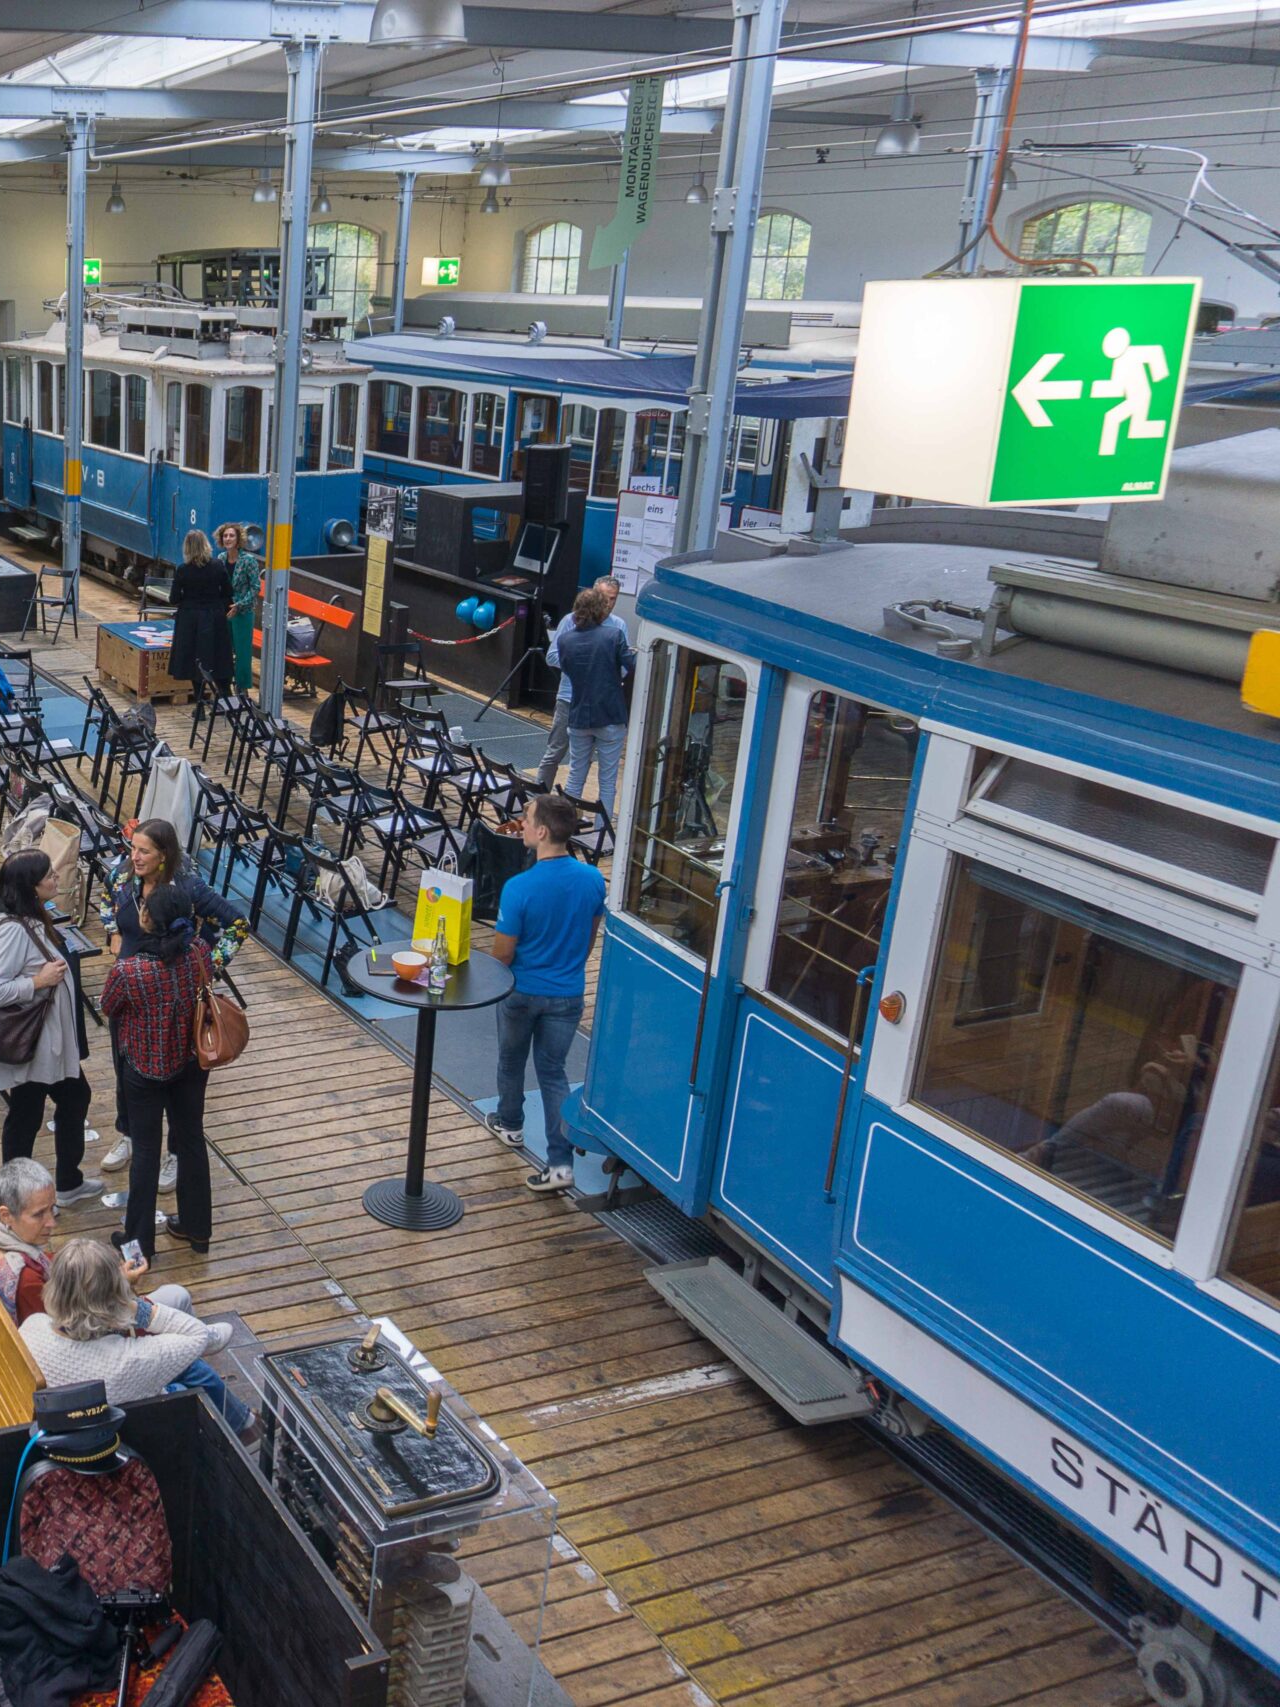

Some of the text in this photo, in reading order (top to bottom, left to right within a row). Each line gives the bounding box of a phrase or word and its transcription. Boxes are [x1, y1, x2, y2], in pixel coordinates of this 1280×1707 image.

[636, 76, 659, 224] WAGENDURCHSICHT
[632, 483, 656, 492] sechs
[647, 504, 664, 514] eins
[190, 508, 197, 525] 8
[742, 518, 757, 528] vier
[1051, 1437, 1279, 1622] STÄDT
